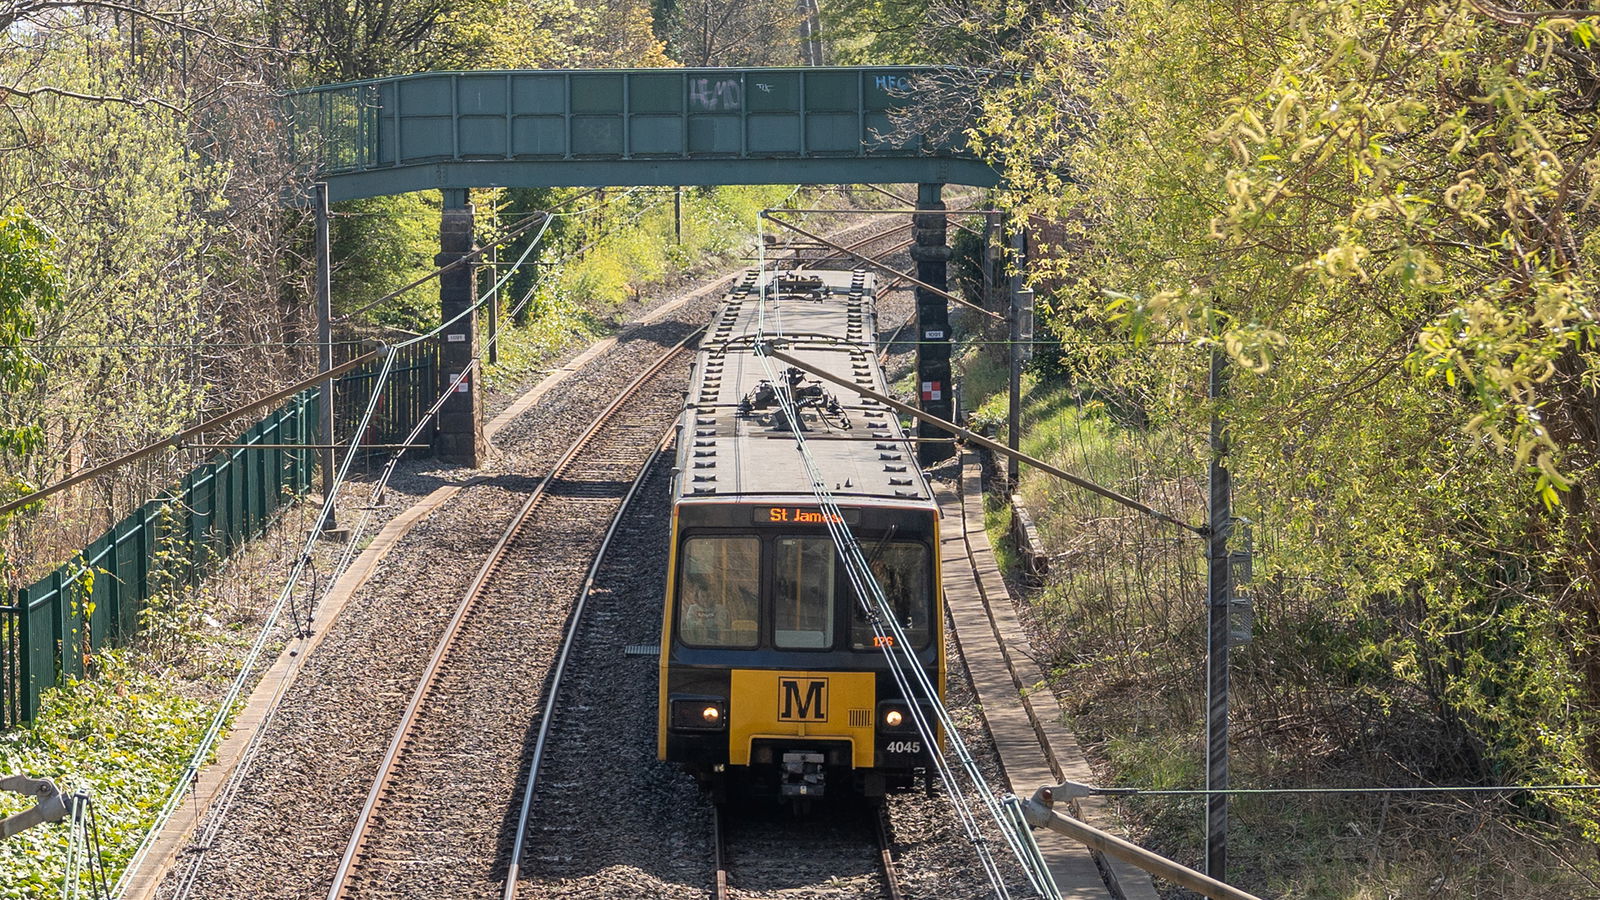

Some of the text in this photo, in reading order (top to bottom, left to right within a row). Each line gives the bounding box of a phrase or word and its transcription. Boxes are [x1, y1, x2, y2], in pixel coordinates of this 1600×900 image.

[769, 508, 788, 521] St
[781, 681, 825, 719] M
[887, 741, 920, 753] 4045
